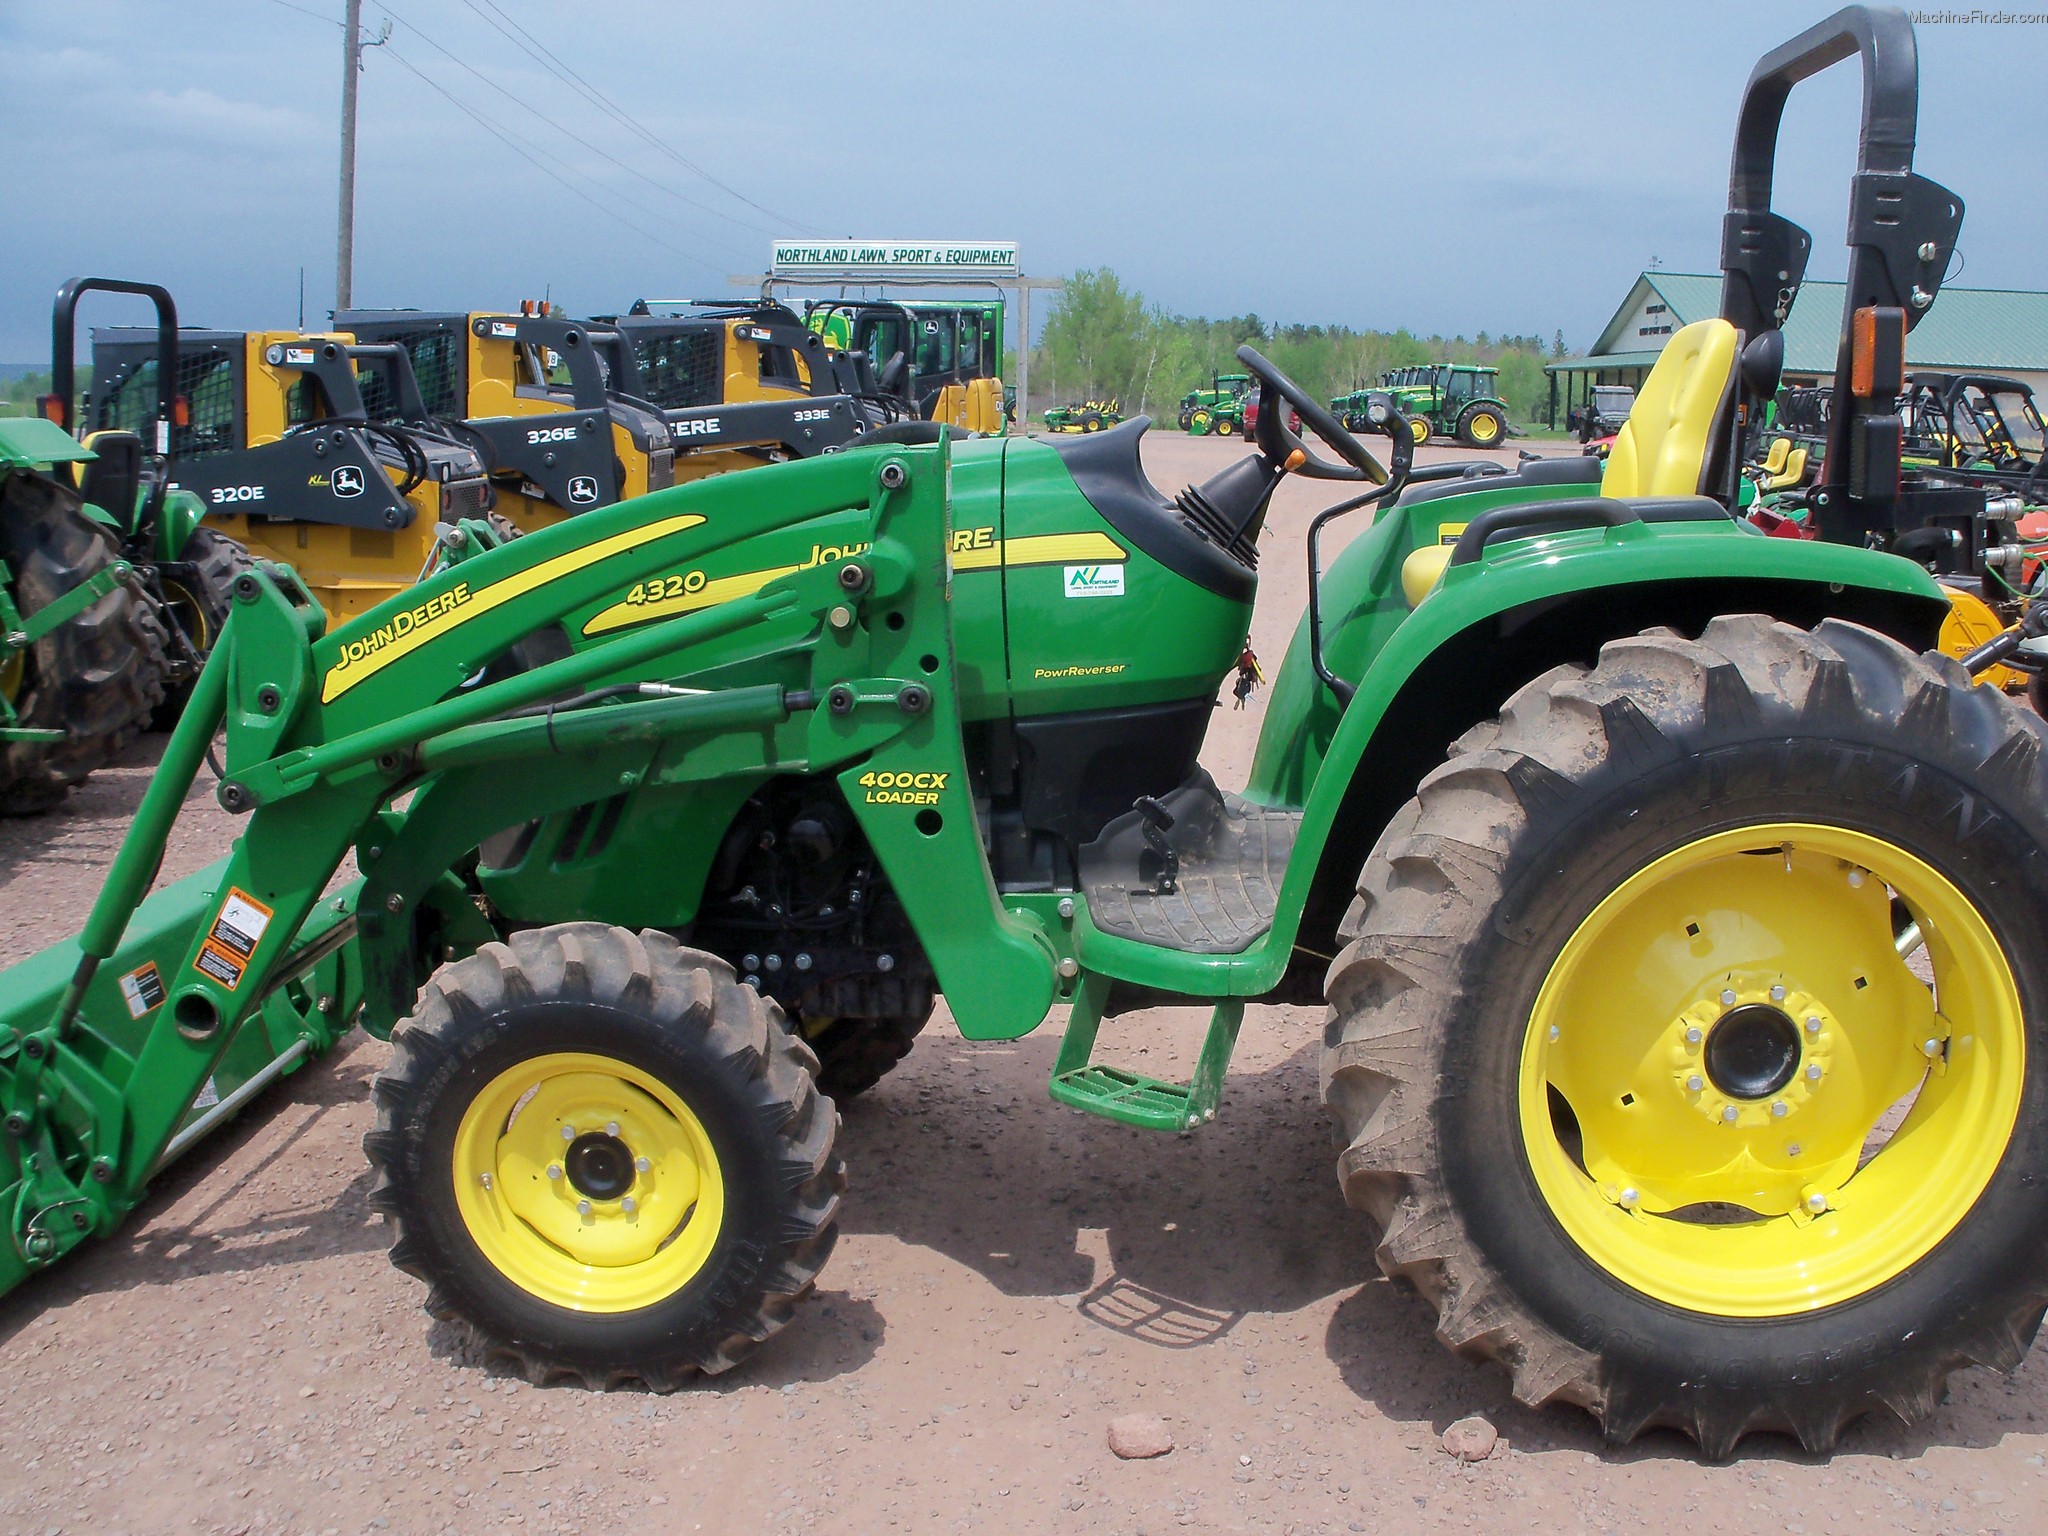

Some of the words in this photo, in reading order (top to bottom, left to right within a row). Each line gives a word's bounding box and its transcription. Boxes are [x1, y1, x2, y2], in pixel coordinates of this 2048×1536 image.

[776, 248, 848, 263] NORTHLAND
[851, 248, 888, 264] LAWN,
[891, 249, 931, 262] SPORT
[934, 251, 942, 262] &
[945, 250, 1015, 264] EQUIPMENT
[794, 409, 830, 422] 333E
[527, 427, 578, 444] 326E
[211, 486, 265, 503] 320E
[626, 570, 706, 605] 4320
[336, 624, 395, 670] JOHN
[392, 582, 473, 638] DEERE
[1034, 664, 1126, 679] PowrReverser
[859, 771, 949, 790] 400CX
[865, 790, 940, 805] LOADER
[1690, 739, 2001, 844] TITAN
